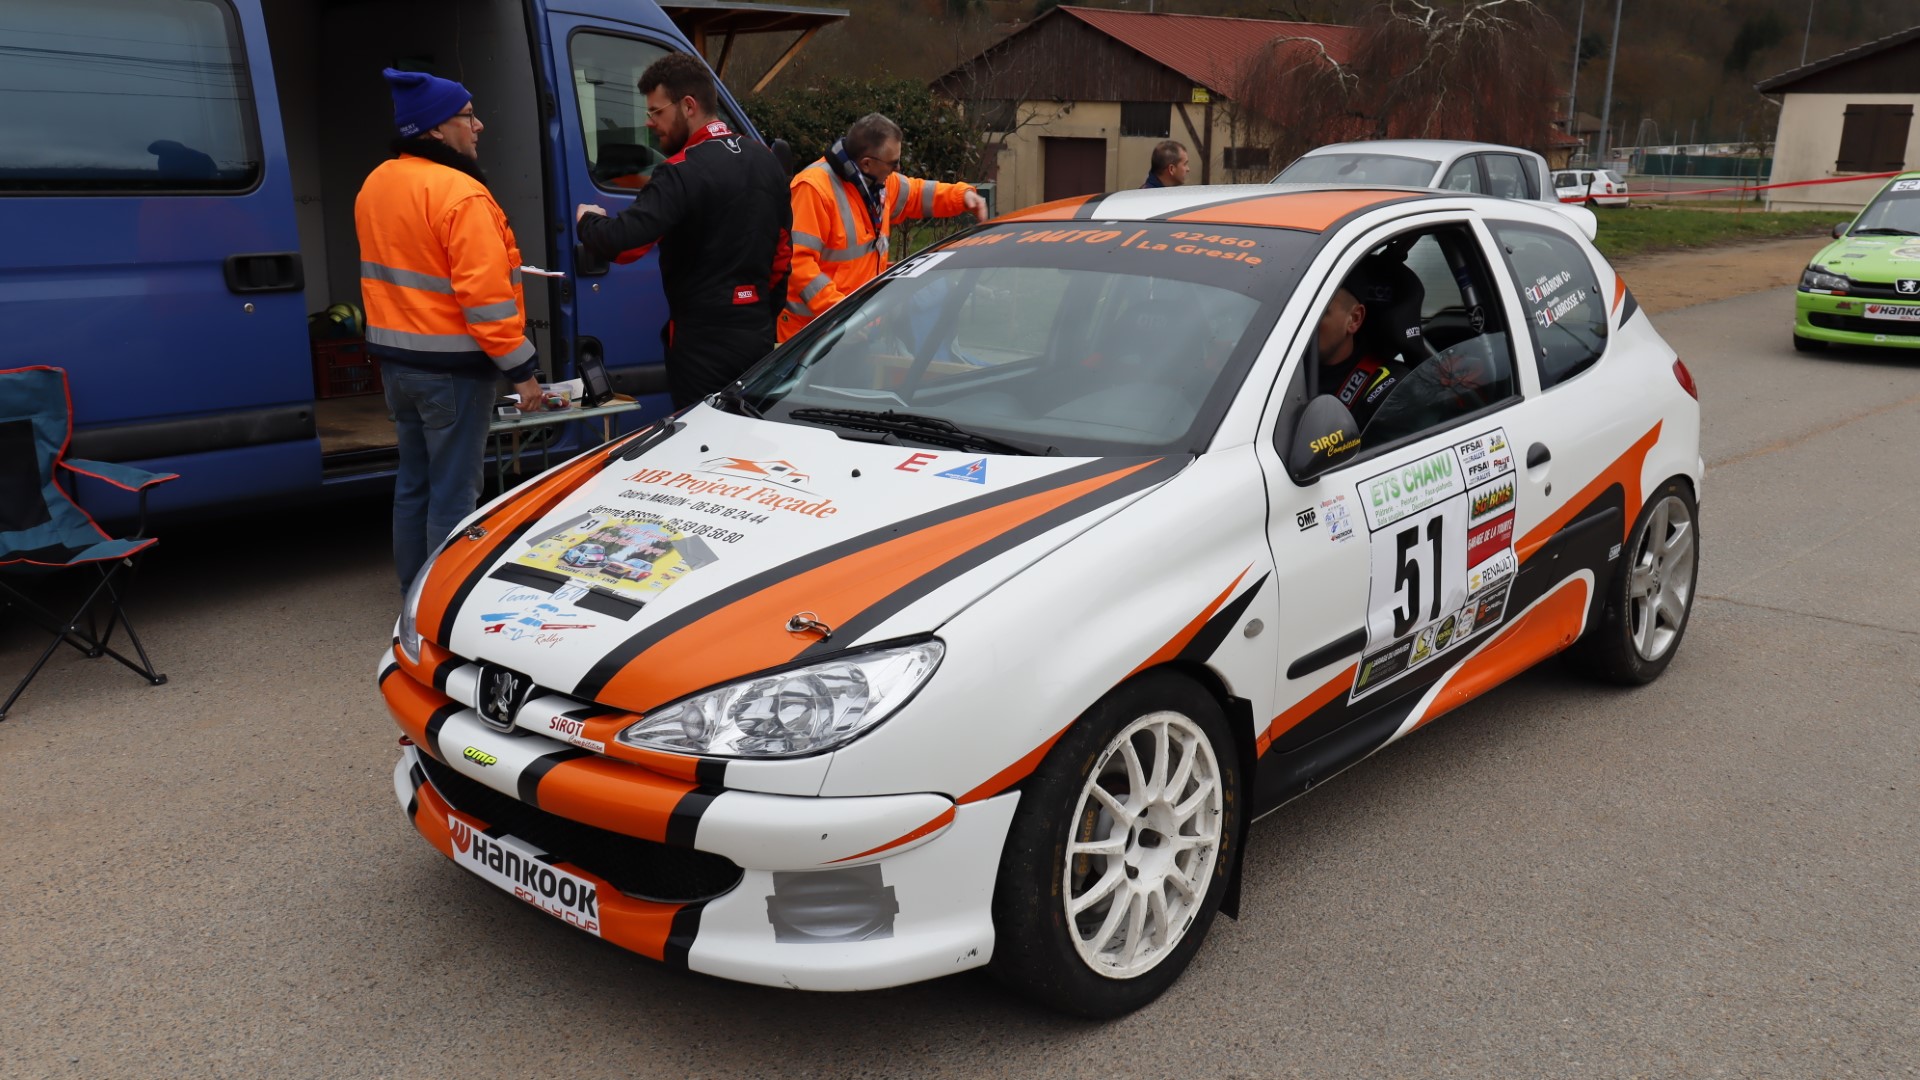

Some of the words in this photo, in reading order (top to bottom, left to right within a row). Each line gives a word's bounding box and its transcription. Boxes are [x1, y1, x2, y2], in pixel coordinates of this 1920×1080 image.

[1169, 231, 1256, 248] 42460
[1136, 240, 1168, 251] La
[1174, 244, 1262, 265] Gresle
[1540, 275, 1564, 298] MARION
[1561, 271, 1572, 283] O+
[1551, 292, 1579, 320] LABROSSE
[1310, 429, 1344, 453] SIROT
[1460, 441, 1482, 455] FFSA
[894, 453, 939, 472] E
[1469, 461, 1488, 476] FFSA
[1369, 474, 1400, 506] ETS
[1401, 453, 1452, 493] CHANU
[622, 468, 673, 485] MB
[661, 471, 752, 498] Project
[743, 487, 839, 519] Façade
[648, 493, 689, 506] MARION
[689, 501, 711, 511] 06
[704, 504, 725, 514] 36
[720, 507, 738, 517] 18
[731, 510, 754, 521] 24
[748, 514, 770, 525] 44
[1297, 511, 1316, 528] OMP
[677, 521, 698, 532] 59
[692, 524, 714, 536] 08
[706, 528, 729, 540] 56
[722, 532, 745, 544] 80
[1393, 515, 1443, 639] 51
[1482, 555, 1512, 583] RENAULT
[498, 585, 541, 602] Team
[534, 633, 565, 648] Rallye
[549, 716, 584, 736] SIROT
[565, 910, 598, 932] CUP
